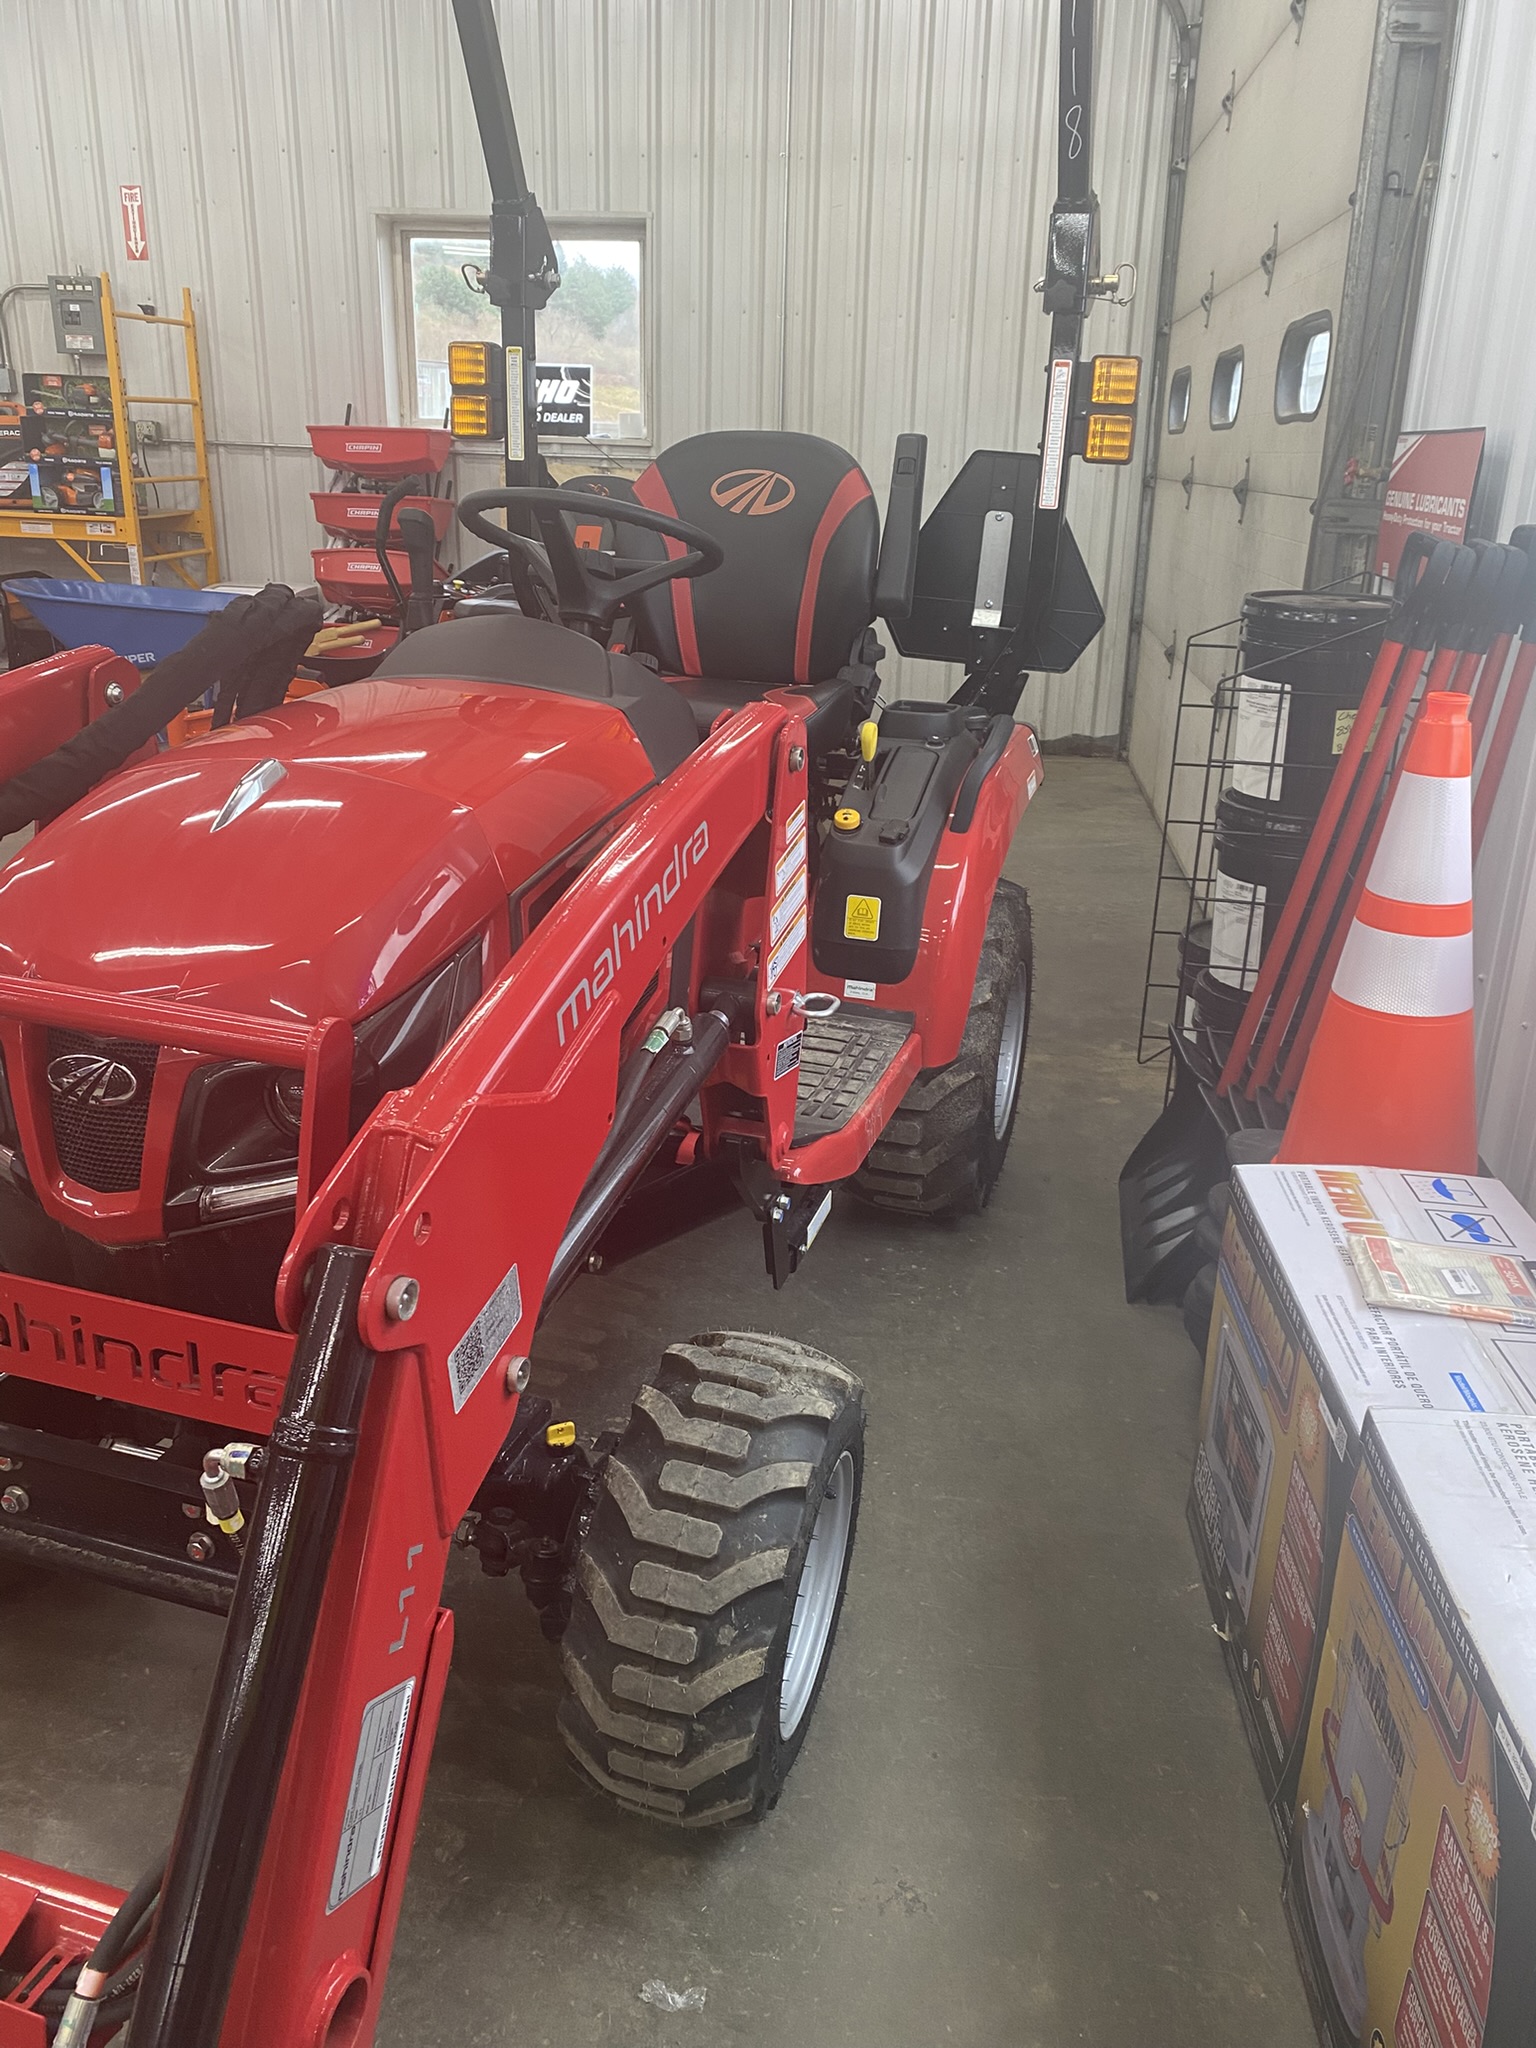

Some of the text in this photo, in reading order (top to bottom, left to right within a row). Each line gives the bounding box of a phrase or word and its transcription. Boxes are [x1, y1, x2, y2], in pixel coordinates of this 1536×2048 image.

[124, 192, 139, 202] FIRE
[543, 412, 584, 423] DEALER
[1385, 490, 1467, 518] GENUINE LUBRICANTS
[349, 562, 380, 570] CHAPIN
[556, 820, 710, 1047] mahindra
[1314, 1169, 1374, 1220] KERO
[1300, 1331, 1326, 1381] HEATER
[1364, 1327, 1407, 1389] PARA INTERIORES
[1404, 1371, 1420, 1382] DE
[1496, 1422, 1535, 1474] KEROSENE
[1512, 1481, 1528, 1500] STYLE
[1364, 1432, 1479, 1682] PORTABLE INDOOR KEROSENE HEATER
[336, 1824, 357, 1902] mahindra
[1443, 1820, 1489, 1946] SAVE $100'S
